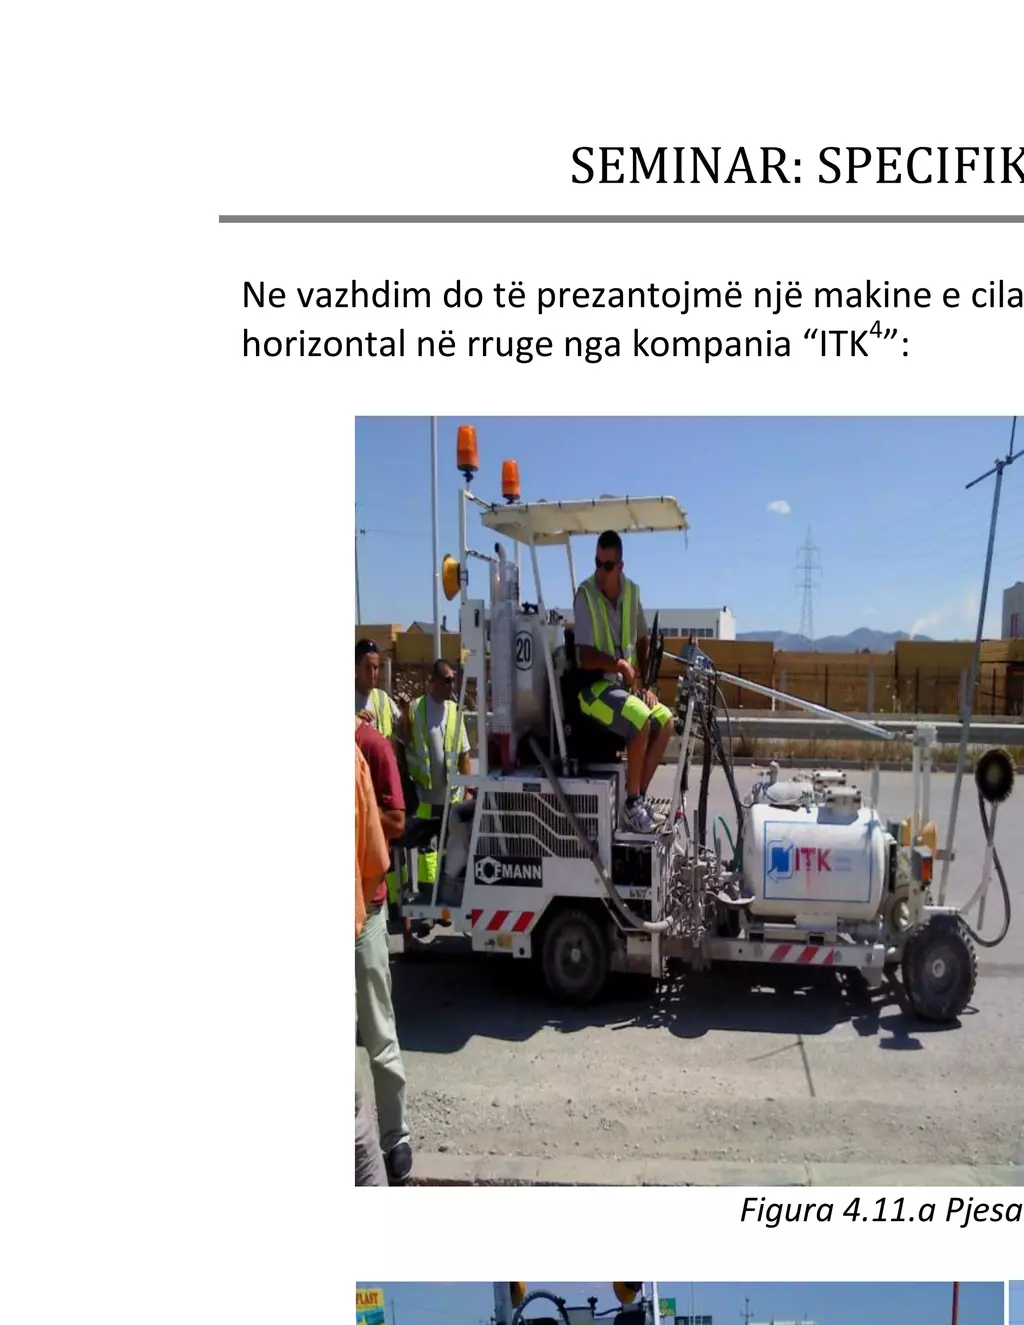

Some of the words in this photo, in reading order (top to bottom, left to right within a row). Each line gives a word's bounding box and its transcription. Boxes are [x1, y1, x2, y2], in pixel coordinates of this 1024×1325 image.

[572, 147, 800, 184] SEMINAR:
[244, 281, 285, 308] Ne
[297, 280, 430, 308] vazhdim
[444, 280, 482, 308] do
[493, 281, 525, 308] të
[539, 281, 742, 314] prezantojmë
[755, 281, 802, 314] një
[815, 280, 931, 308] makine
[943, 288, 960, 308] e
[972, 280, 1022, 308] cila
[244, 329, 404, 357] horizontal
[418, 330, 455, 357] në
[469, 337, 552, 363] rruge
[566, 337, 620, 363] nga
[634, 329, 790, 363] kompania
[516, 638, 530, 662] 20
[475, 857, 542, 884] HOFMANN
[795, 847, 831, 871] ITK
[741, 1197, 833, 1228] Figura
[843, 1197, 935, 1222] 4.11.a
[946, 1197, 1022, 1228] Pjesa
